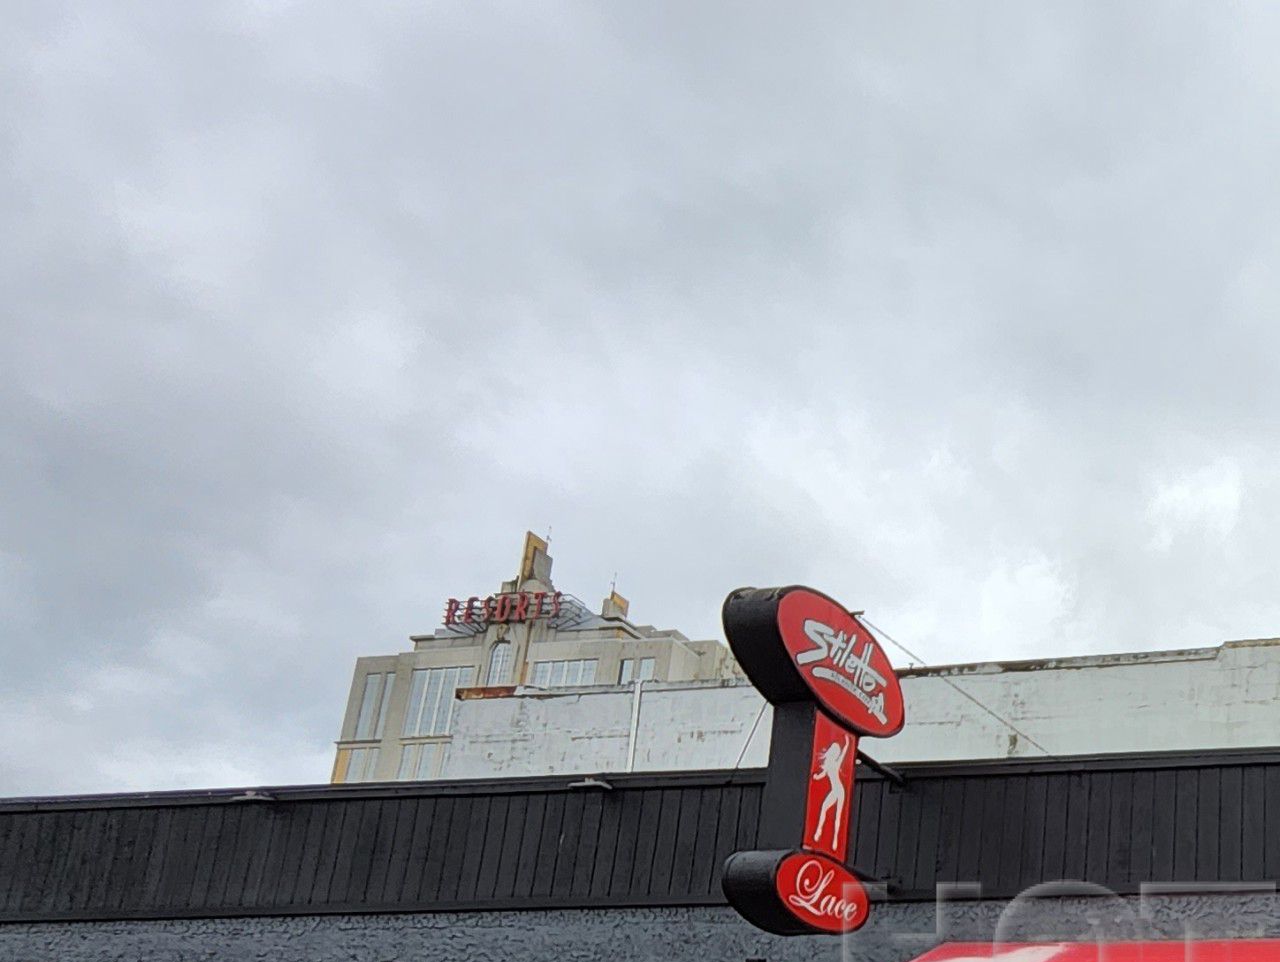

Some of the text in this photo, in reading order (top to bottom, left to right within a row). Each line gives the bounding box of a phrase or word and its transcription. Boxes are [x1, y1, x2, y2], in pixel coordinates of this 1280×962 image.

[444, 591, 562, 626] RESORTS
[797, 620, 887, 692] Stiletto
[789, 860, 857, 921] Lace
